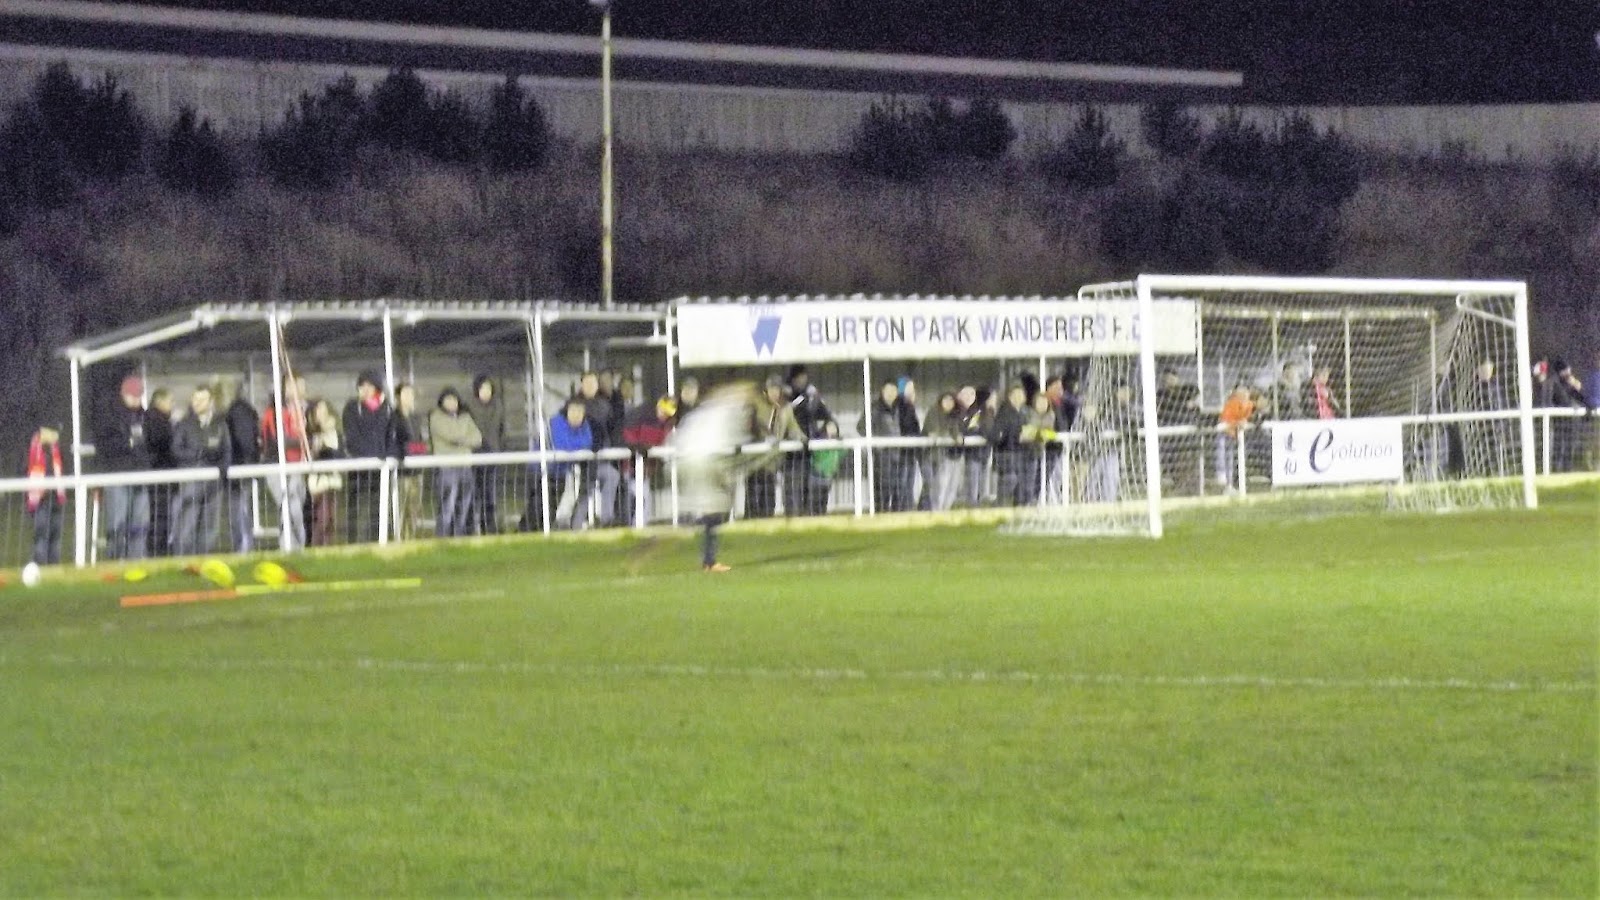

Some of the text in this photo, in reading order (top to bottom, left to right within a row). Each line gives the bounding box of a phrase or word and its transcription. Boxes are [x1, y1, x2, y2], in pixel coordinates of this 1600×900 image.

[807, 315, 905, 345] BURTON
[912, 314, 971, 343] PARK
[978, 313, 1107, 343] WANDERERS
